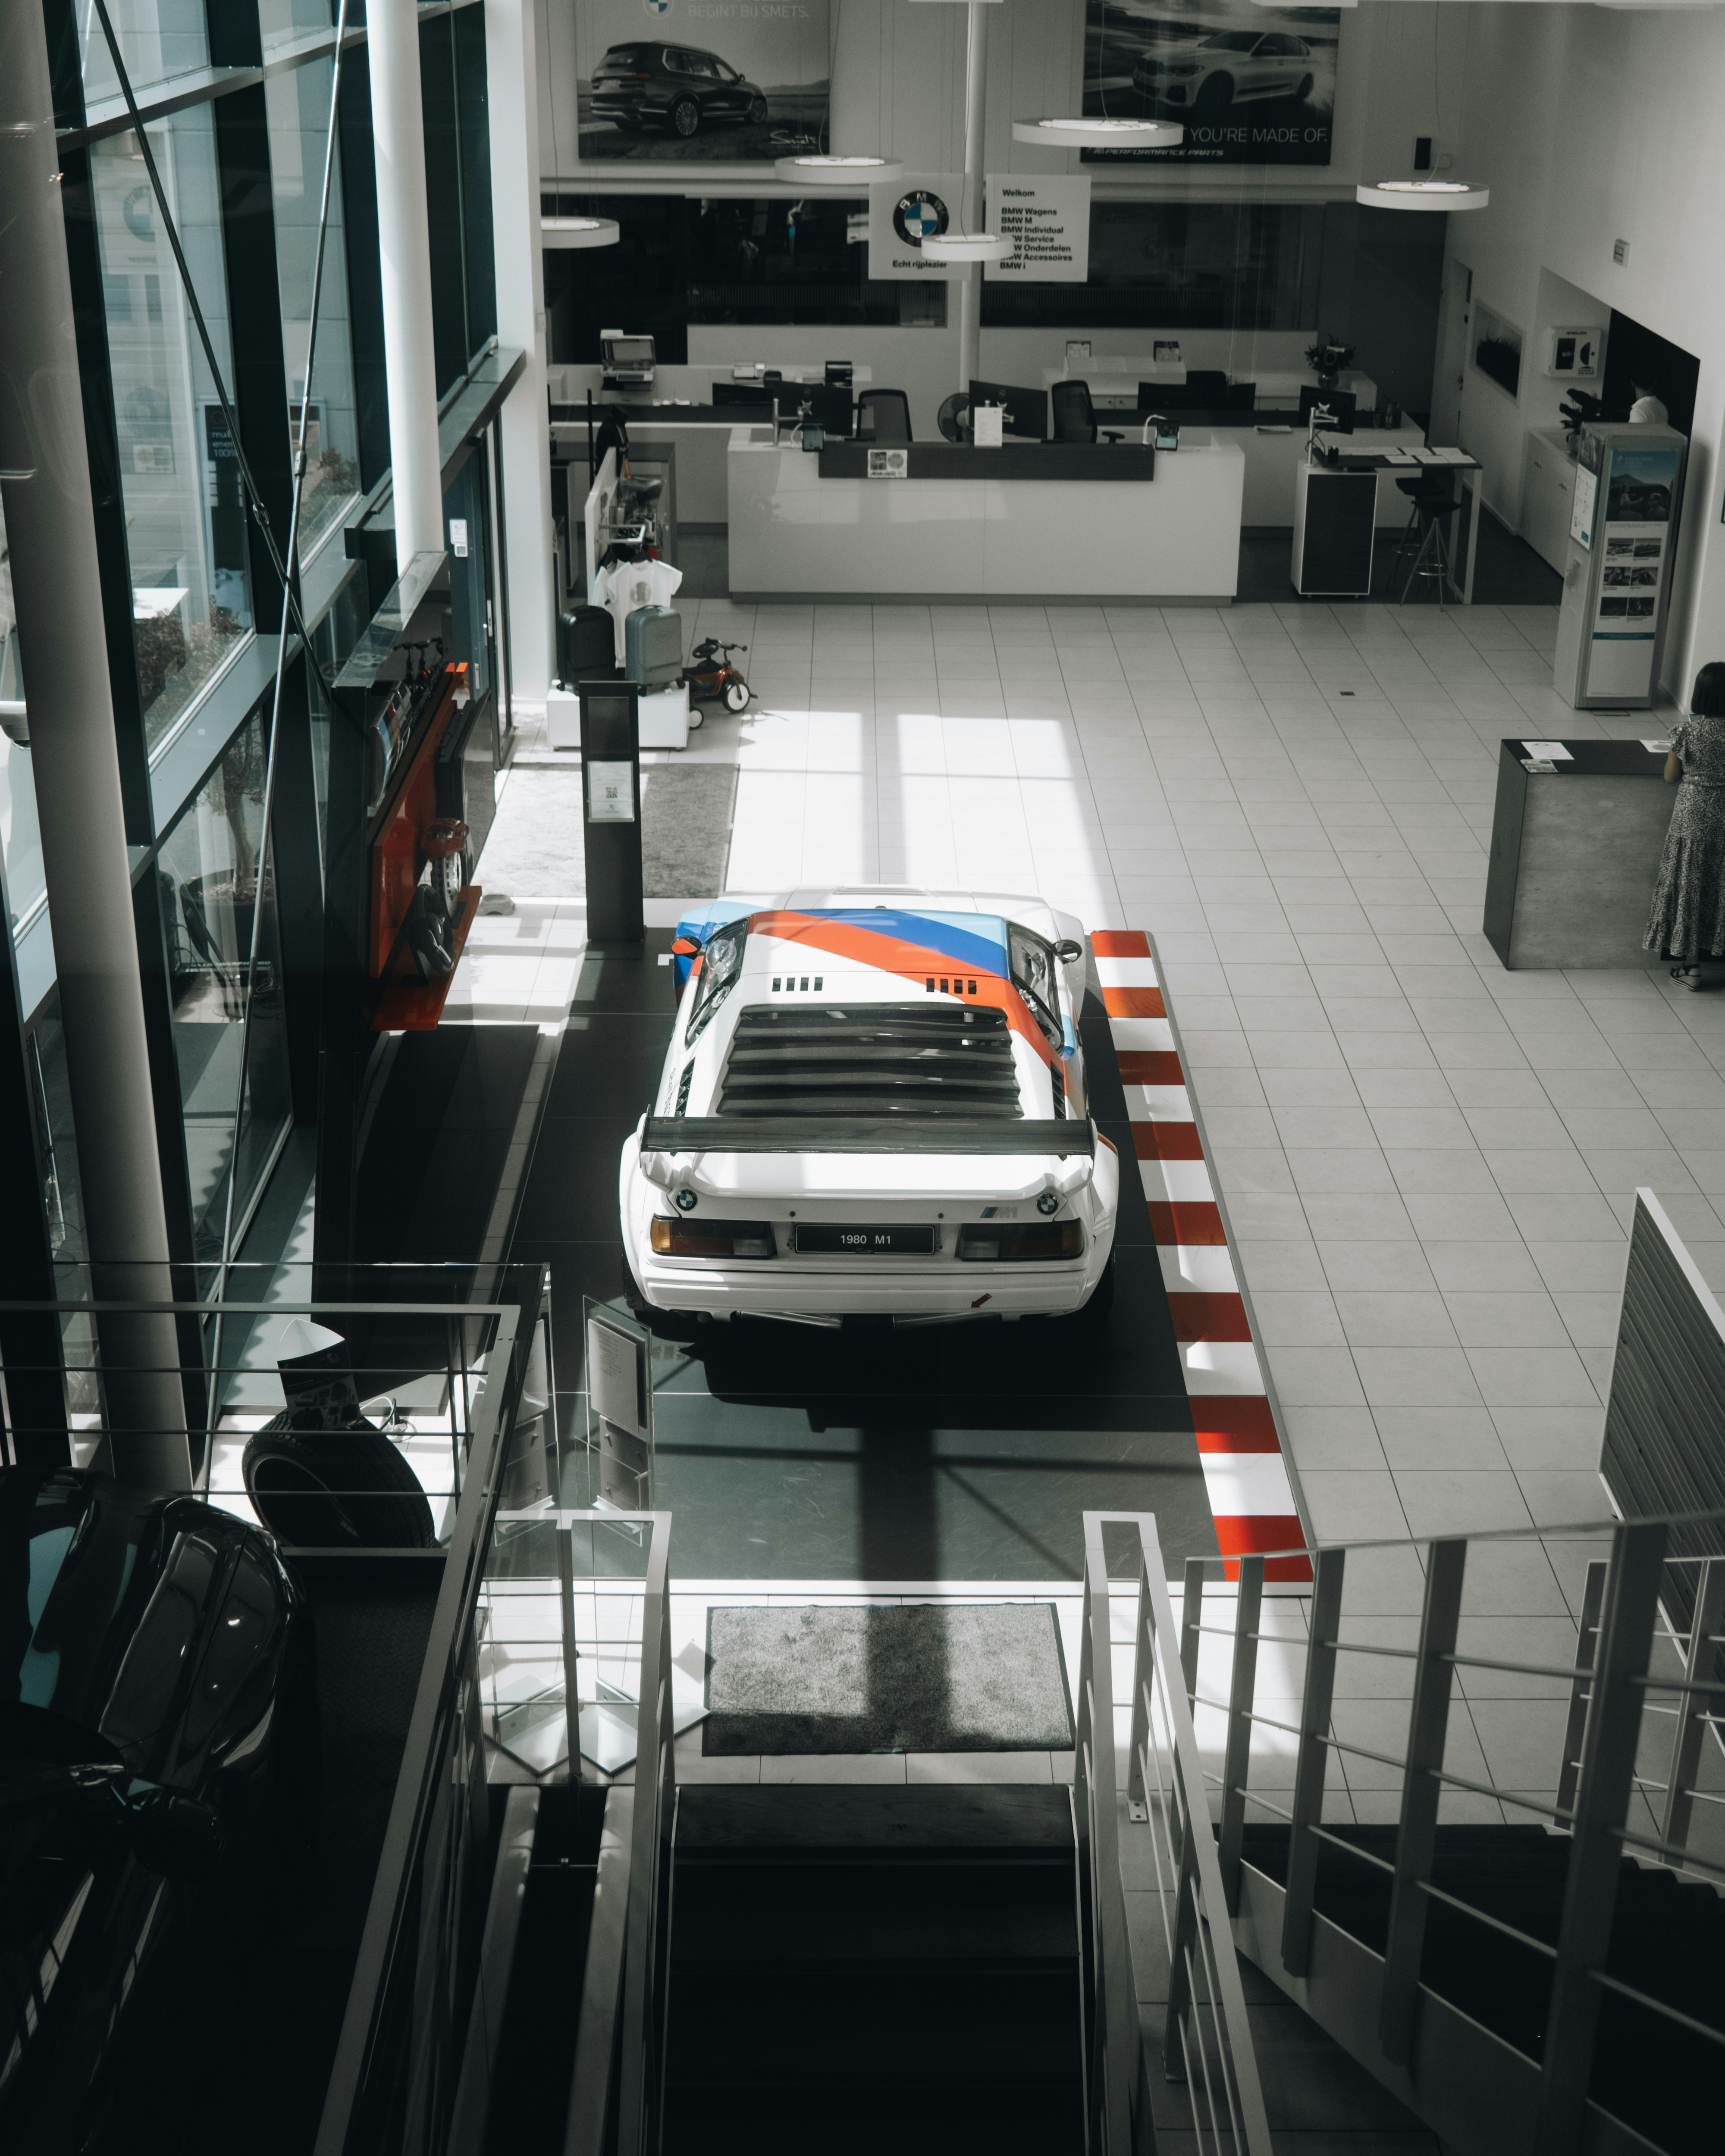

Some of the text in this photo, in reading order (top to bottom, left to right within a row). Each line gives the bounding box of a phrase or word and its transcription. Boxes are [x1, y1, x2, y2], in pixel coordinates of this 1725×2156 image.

[688, 5, 736, 18] BEGINT
[762, 5, 809, 18] SMETS.
[1190, 128, 1247, 142] YOU'RE
[1252, 128, 1299, 142] MADE
[1304, 128, 1327, 143] OF.
[899, 192, 944, 210] BMW
[1025, 208, 1057, 217] Wagens
[1023, 253, 1073, 261] Accessoires
[913, 260, 947, 270] rijplezier
[841, 1235, 891, 1244] 1980 M1
